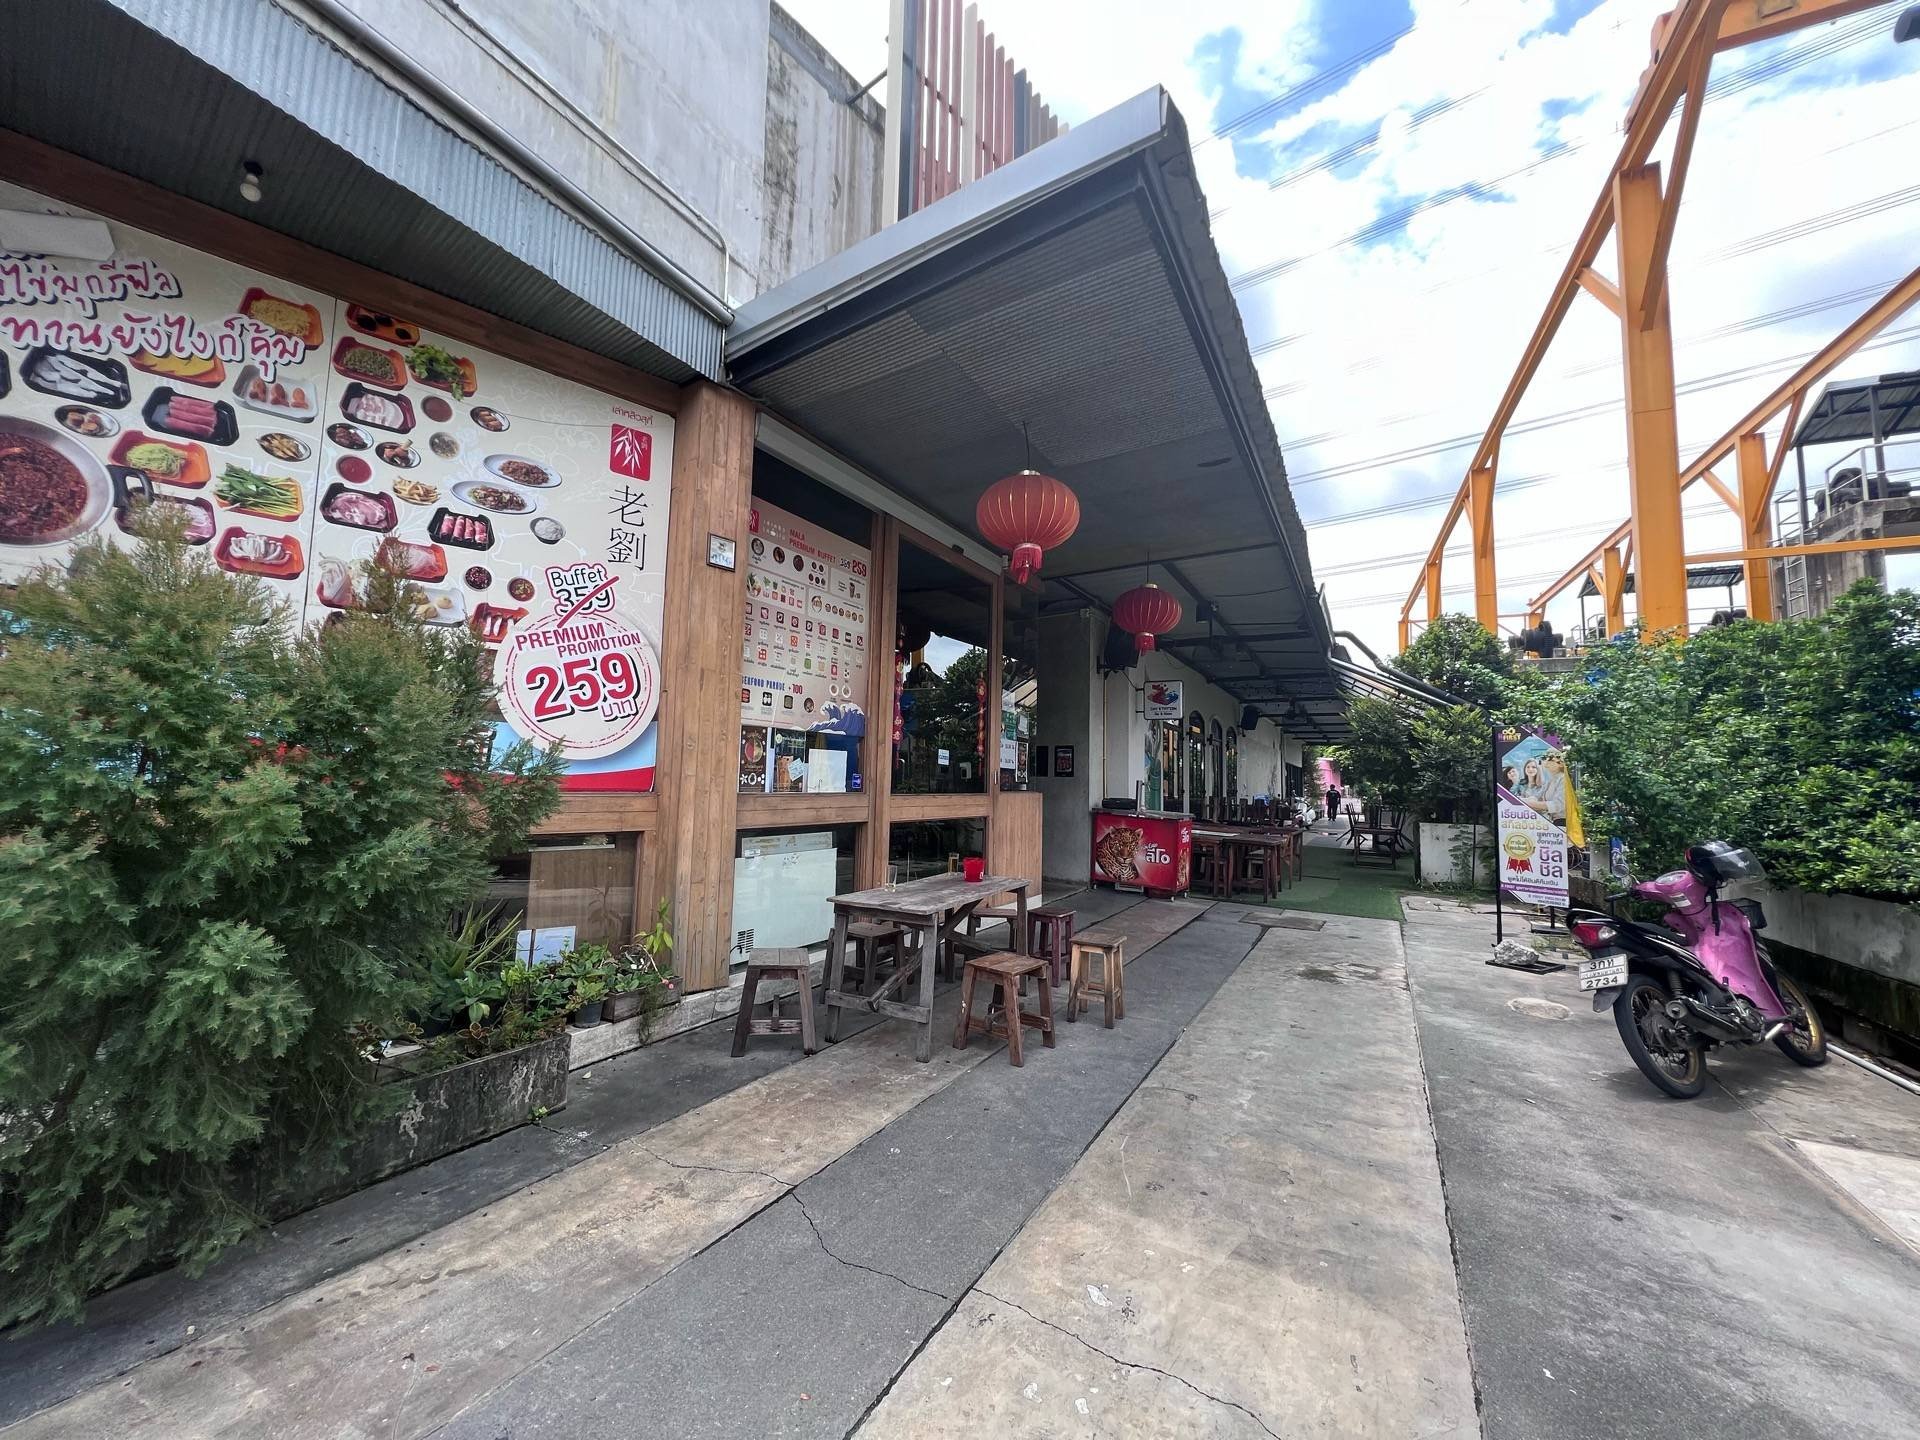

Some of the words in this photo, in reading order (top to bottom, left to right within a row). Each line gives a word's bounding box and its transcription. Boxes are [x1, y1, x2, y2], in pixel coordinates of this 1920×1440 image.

[0, 259, 176, 313] ไข่มุกรีฟิล
[606, 484, 648, 571] 老劉
[550, 567, 604, 588] Buffet
[555, 584, 611, 614] 359
[514, 622, 606, 652] PREMIUM
[557, 632, 641, 658] PROMOTION
[526, 652, 635, 719] 259
[601, 699, 634, 718] บาท
[1145, 848, 1171, 865] ลีโอ
[1539, 846, 1563, 863] ชิล
[1539, 861, 1563, 879] ชิล
[1586, 975, 1618, 989] 2734
